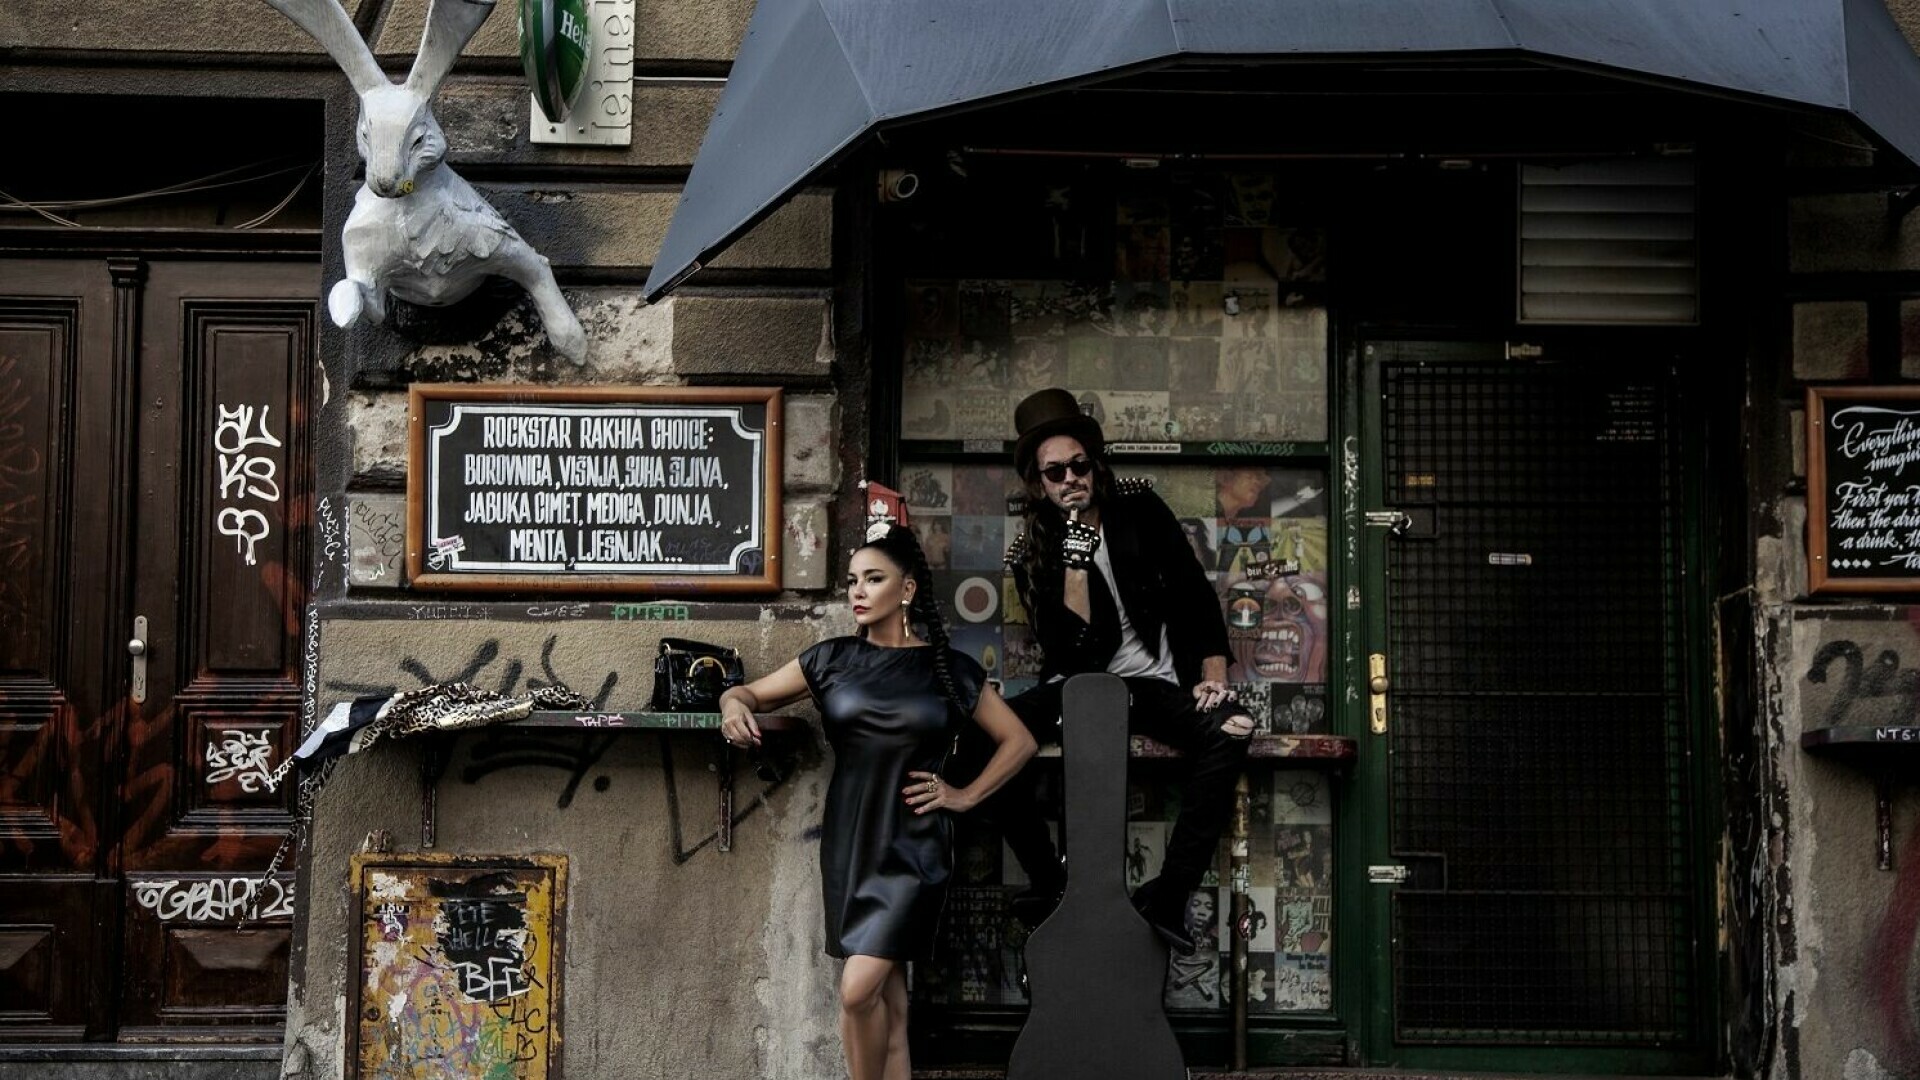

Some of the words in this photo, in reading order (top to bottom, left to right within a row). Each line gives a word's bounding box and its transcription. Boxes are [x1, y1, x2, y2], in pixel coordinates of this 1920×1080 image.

[483, 416, 571, 449] ROCKSTAR
[580, 417, 644, 450] RAKHIA
[651, 418, 714, 450] CHOICE:
[1837, 417, 1920, 458] Everythin
[625, 455, 665, 488] SUHA
[1863, 441, 1920, 477] imagin
[464, 492, 531, 524] JABUKA
[534, 492, 584, 526] CIMET,
[587, 492, 652, 528] MEDICA,
[654, 493, 722, 528] DUNJA,
[1832, 475, 1889, 513] First
[1883, 493, 1911, 513] you
[1830, 509, 1867, 530] then
[1866, 507, 1892, 529] the
[510, 528, 576, 566] MENTA,
[1839, 537, 1854, 550] a
